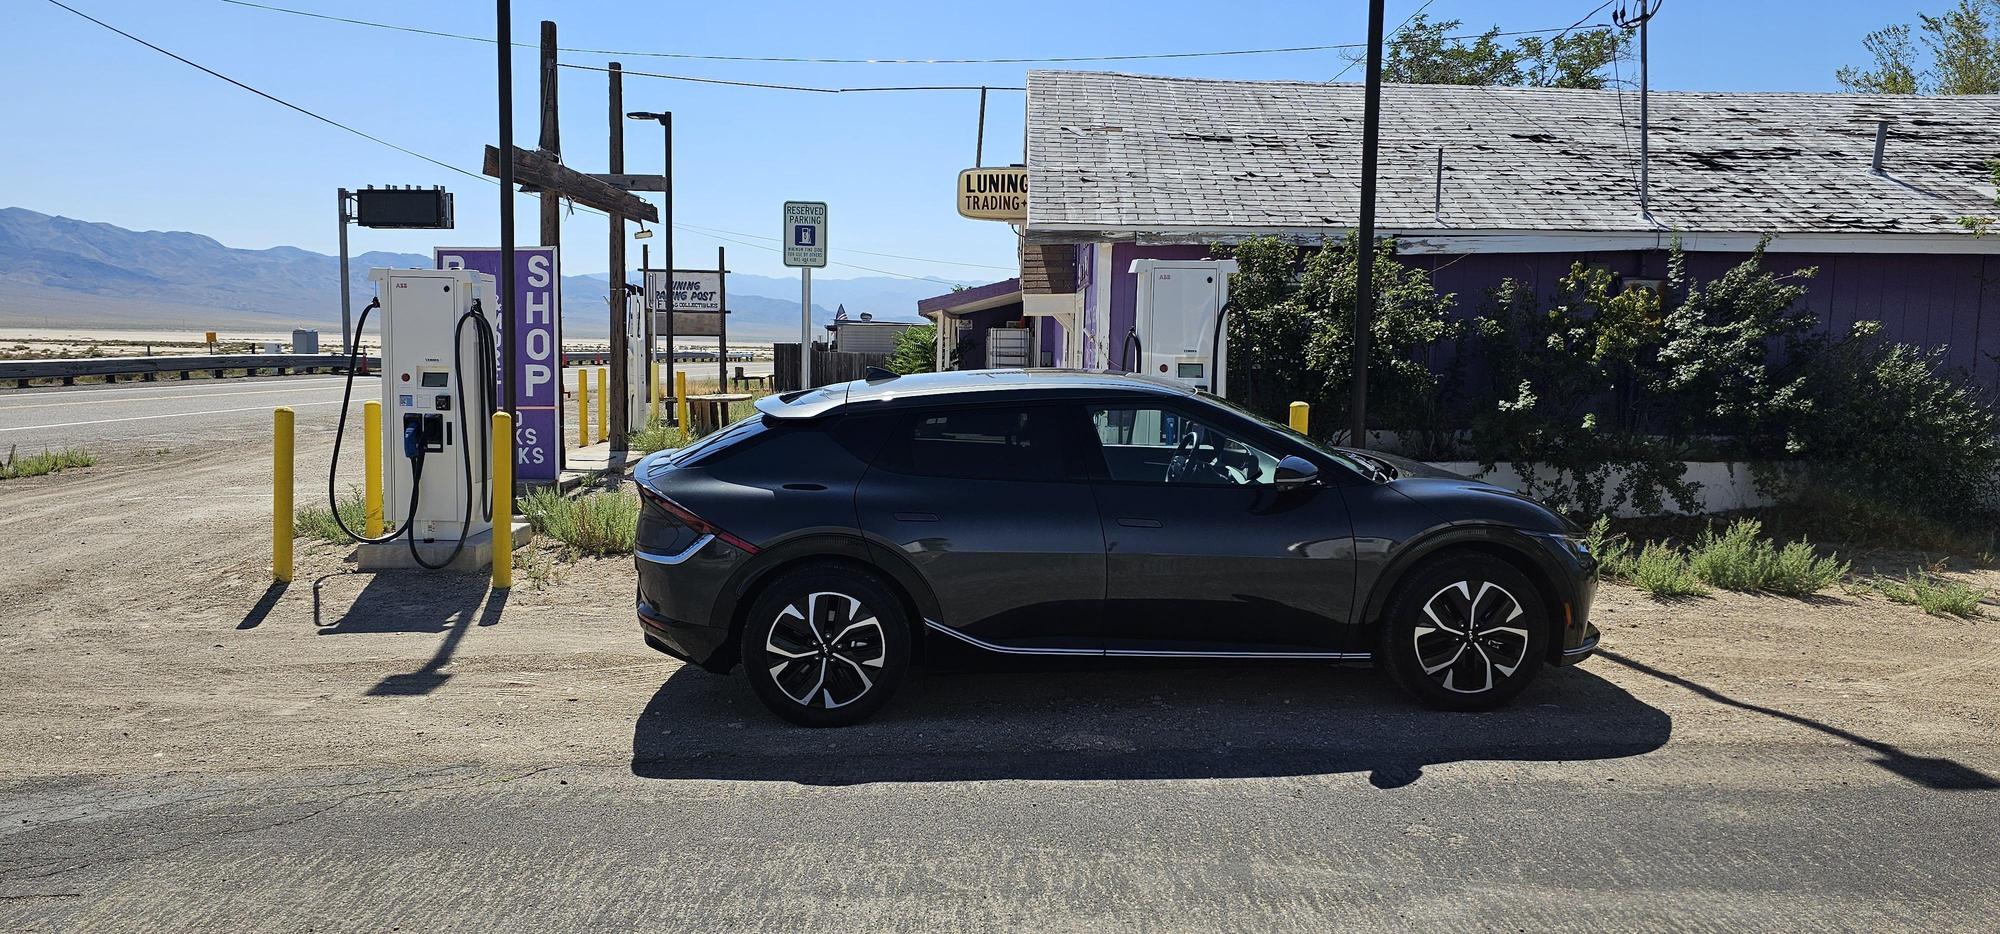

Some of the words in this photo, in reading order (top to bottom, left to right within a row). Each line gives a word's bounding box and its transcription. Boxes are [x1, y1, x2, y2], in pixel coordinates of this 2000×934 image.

[966, 174, 1028, 193] LUNING
[965, 195, 1020, 211] TRADING
[787, 206, 824, 215] RESERVED
[790, 216, 821, 224] PARKING
[690, 291, 717, 301] POST
[525, 255, 552, 397] SHOP
